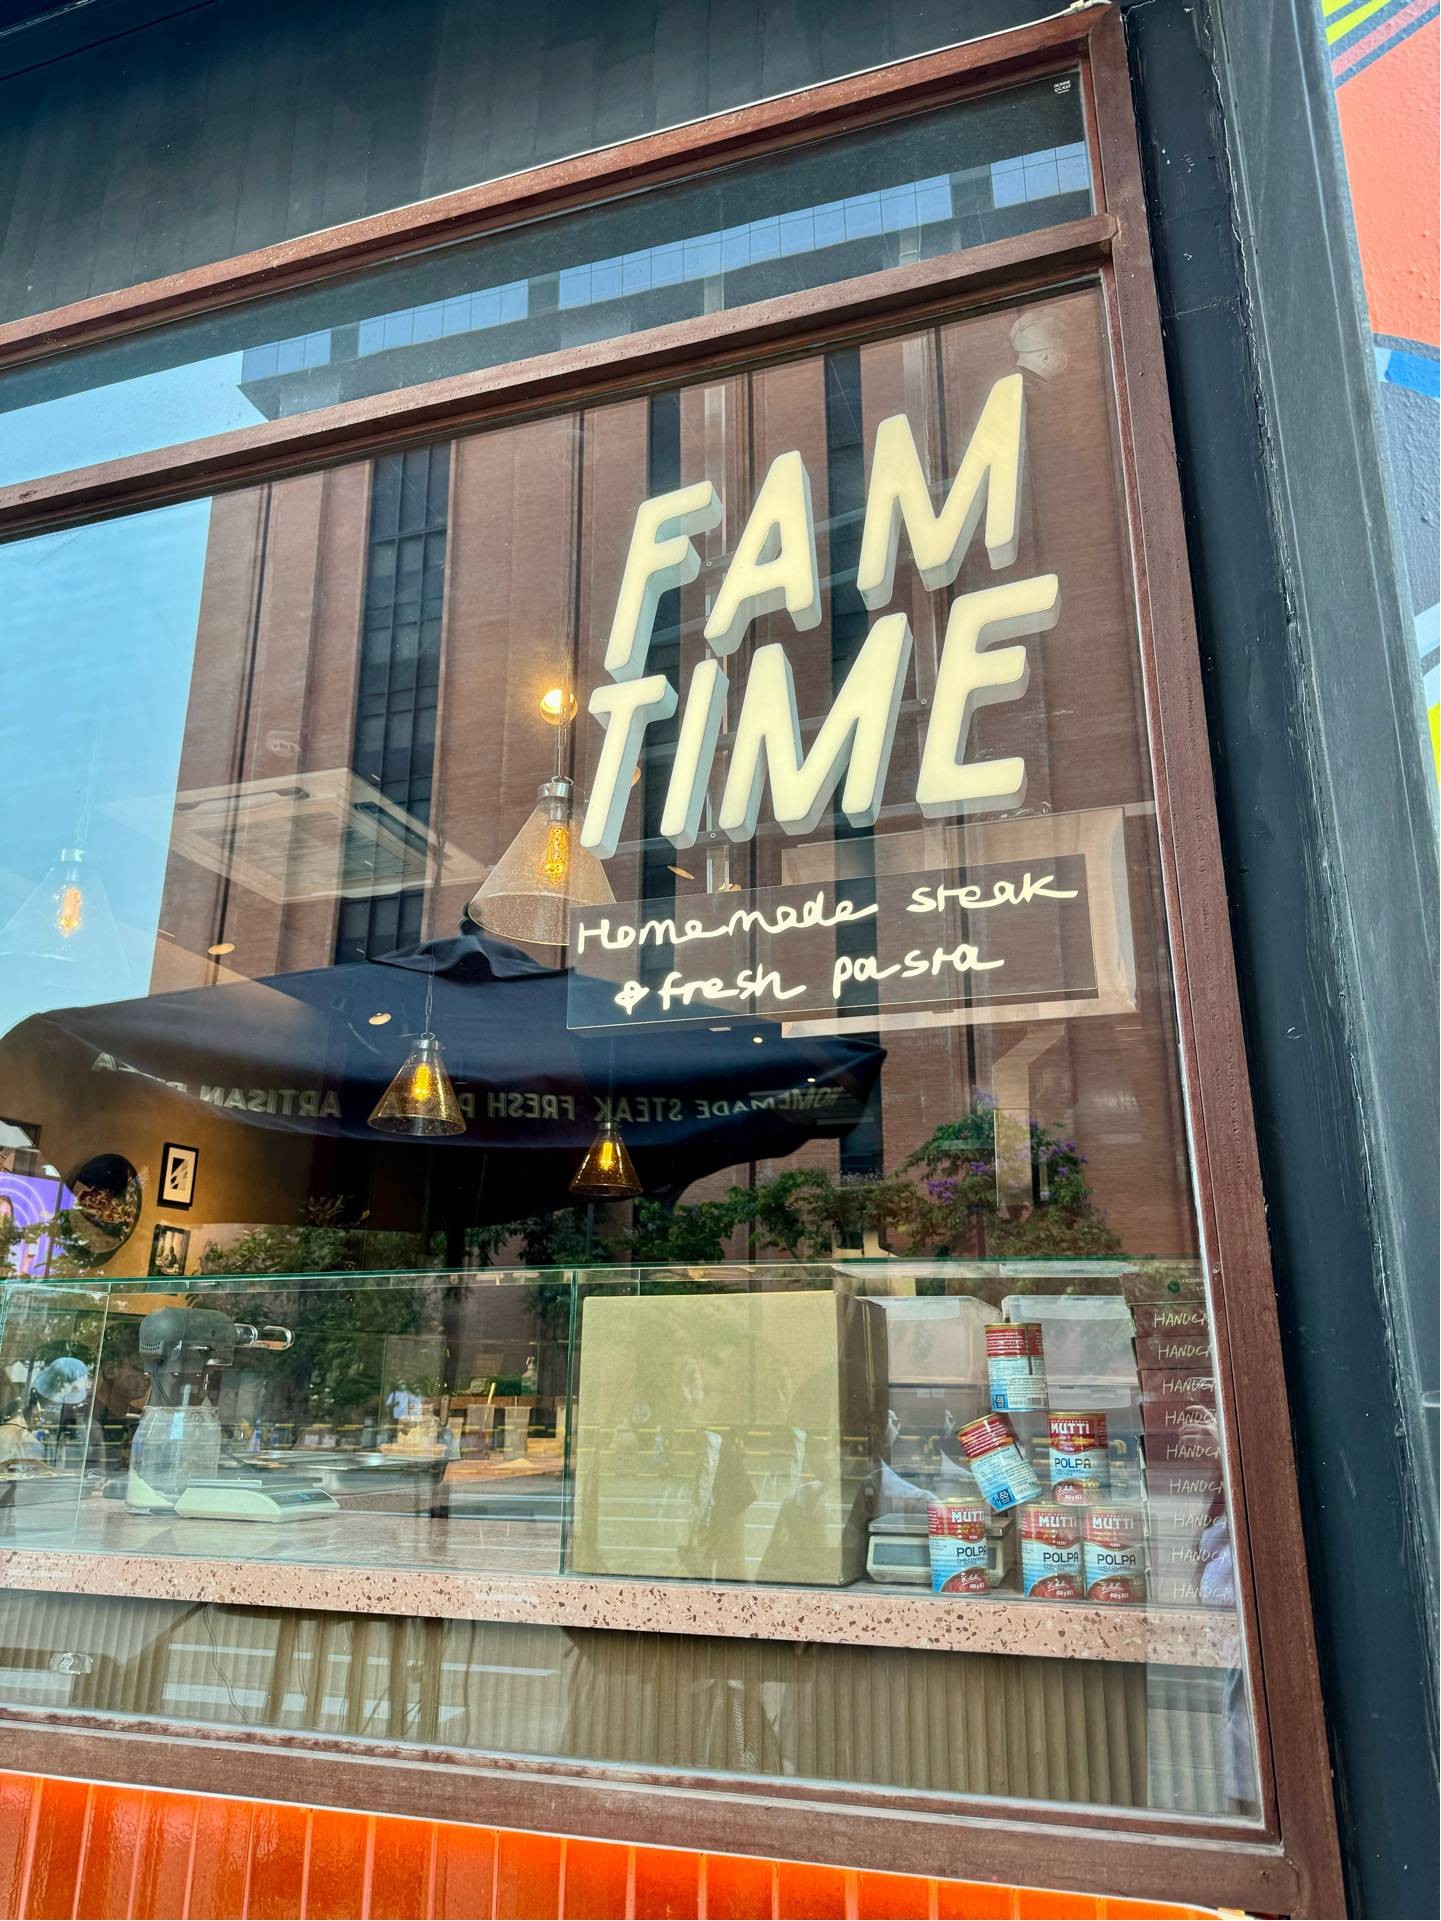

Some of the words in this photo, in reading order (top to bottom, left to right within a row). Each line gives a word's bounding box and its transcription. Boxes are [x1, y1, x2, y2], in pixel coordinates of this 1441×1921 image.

[604, 373, 1023, 682] FAM
[580, 573, 1062, 859] TIME
[577, 890, 879, 953] Homemade
[906, 872, 1078, 914] steak
[657, 963, 807, 1011] fresh
[831, 946, 1005, 999] pasta
[1050, 1422, 1090, 1434] MUTTI
[1054, 1457, 1091, 1469] POLPA
[1039, 1515, 1077, 1528] MUTTI
[1092, 1517, 1134, 1530] MUTTI
[1042, 1551, 1079, 1563] POLPA
[1097, 1554, 1137, 1566] POLPA
